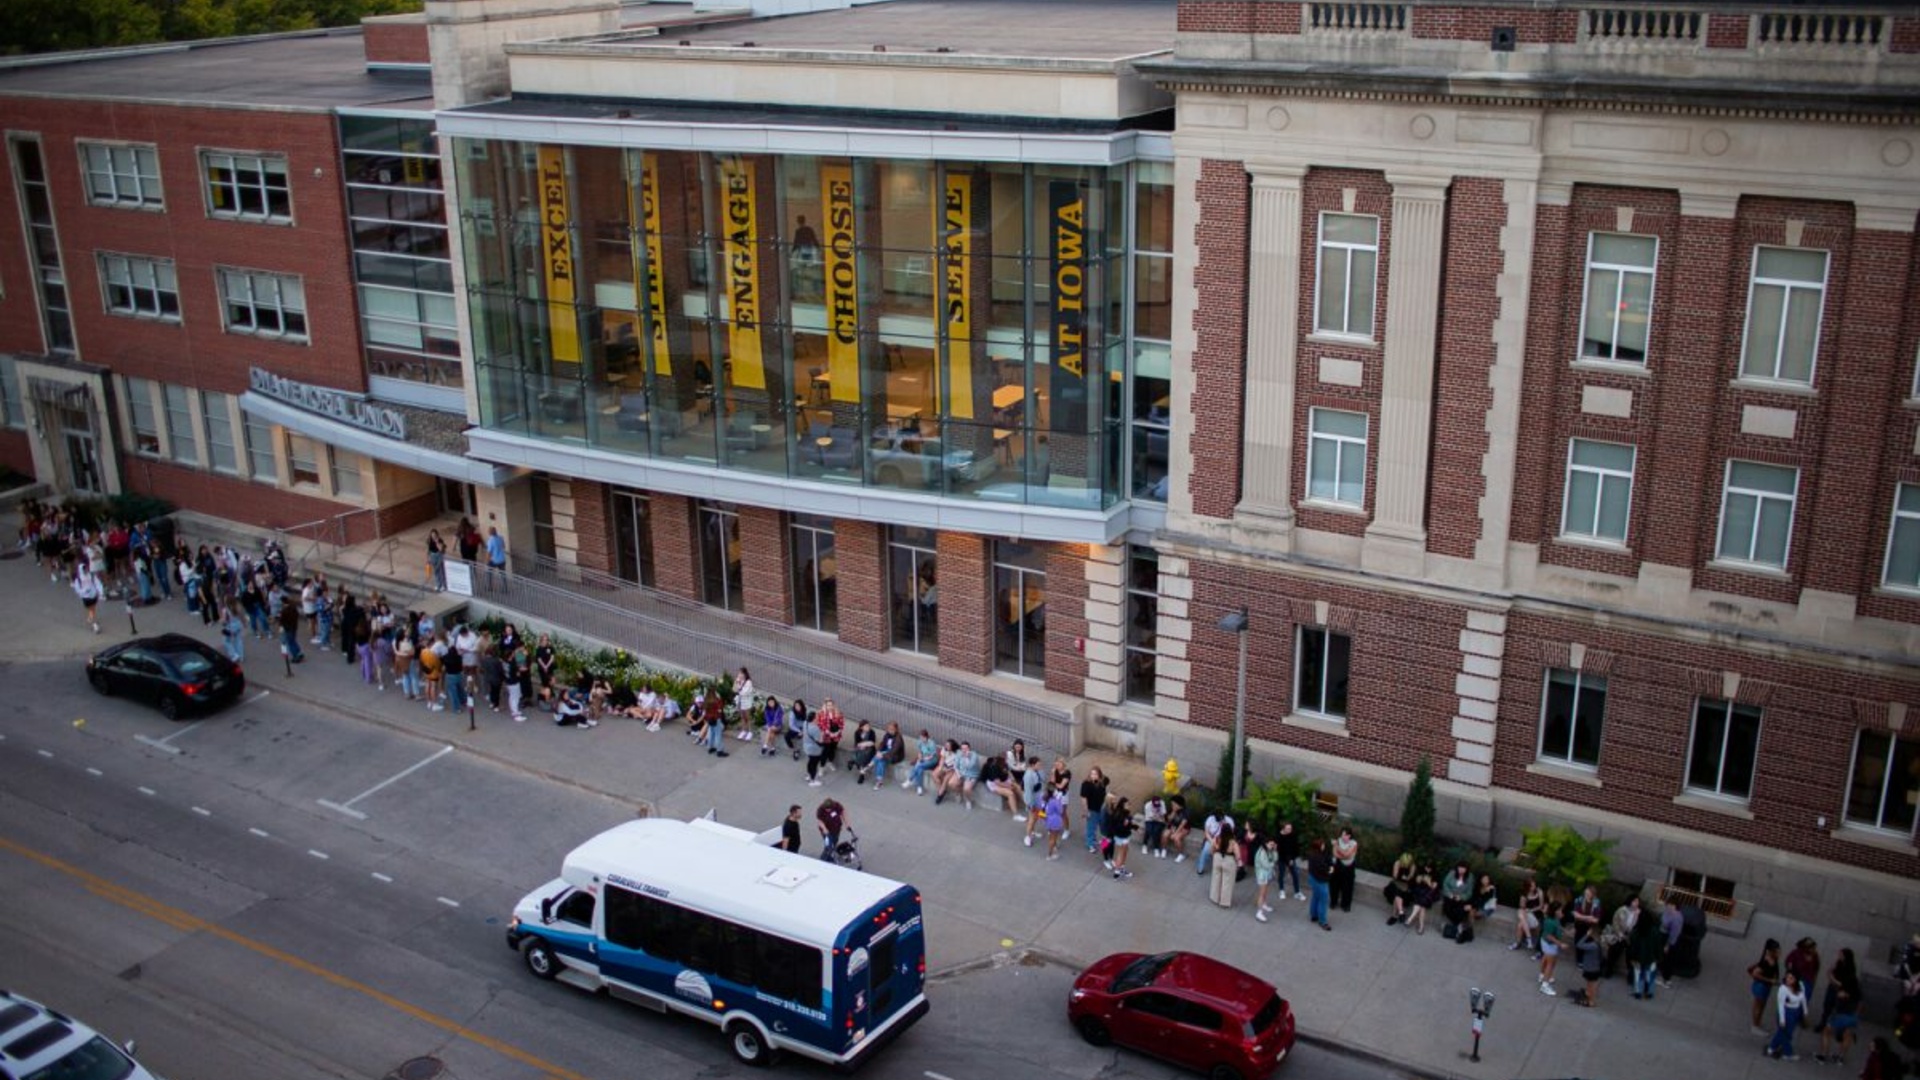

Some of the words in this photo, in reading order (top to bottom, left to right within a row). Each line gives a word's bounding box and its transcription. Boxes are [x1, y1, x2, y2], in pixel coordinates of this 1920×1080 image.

[544, 160, 570, 281] EXCEL
[729, 174, 756, 333] ENGAGE
[830, 180, 856, 344] CHOOSE
[947, 187, 964, 323] SERVE
[1057, 199, 1083, 314] IOWA
[1059, 324, 1083, 379] AT
[354, 402, 405, 439] UNION
